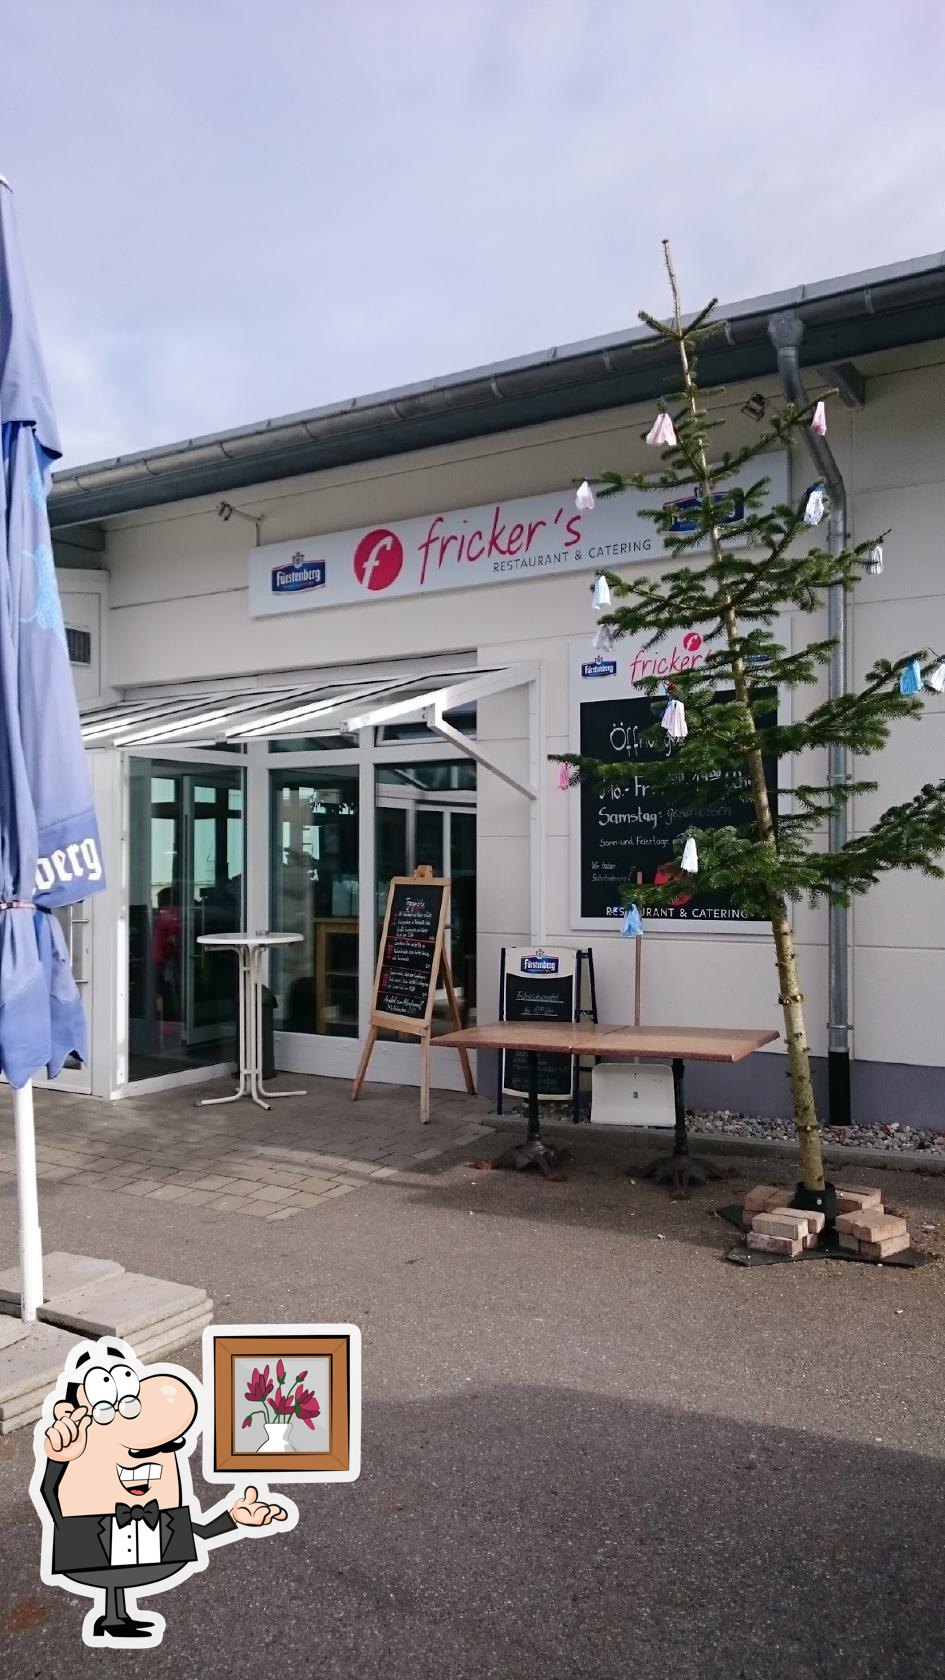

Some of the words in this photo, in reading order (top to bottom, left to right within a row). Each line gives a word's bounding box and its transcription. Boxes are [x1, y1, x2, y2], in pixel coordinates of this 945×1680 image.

[417, 505, 582, 585] fricker's
[493, 551, 569, 573] RESTAURANT
[574, 549, 583, 561] &
[588, 539, 652, 559] CATERING
[276, 568, 321, 587] Fürstenberg
[629, 646, 711, 686] fricker'
[599, 807, 662, 829] Samstag:
[606, 906, 674, 918] RESURANT
[680, 908, 688, 917] &
[692, 908, 748, 919] CATERING
